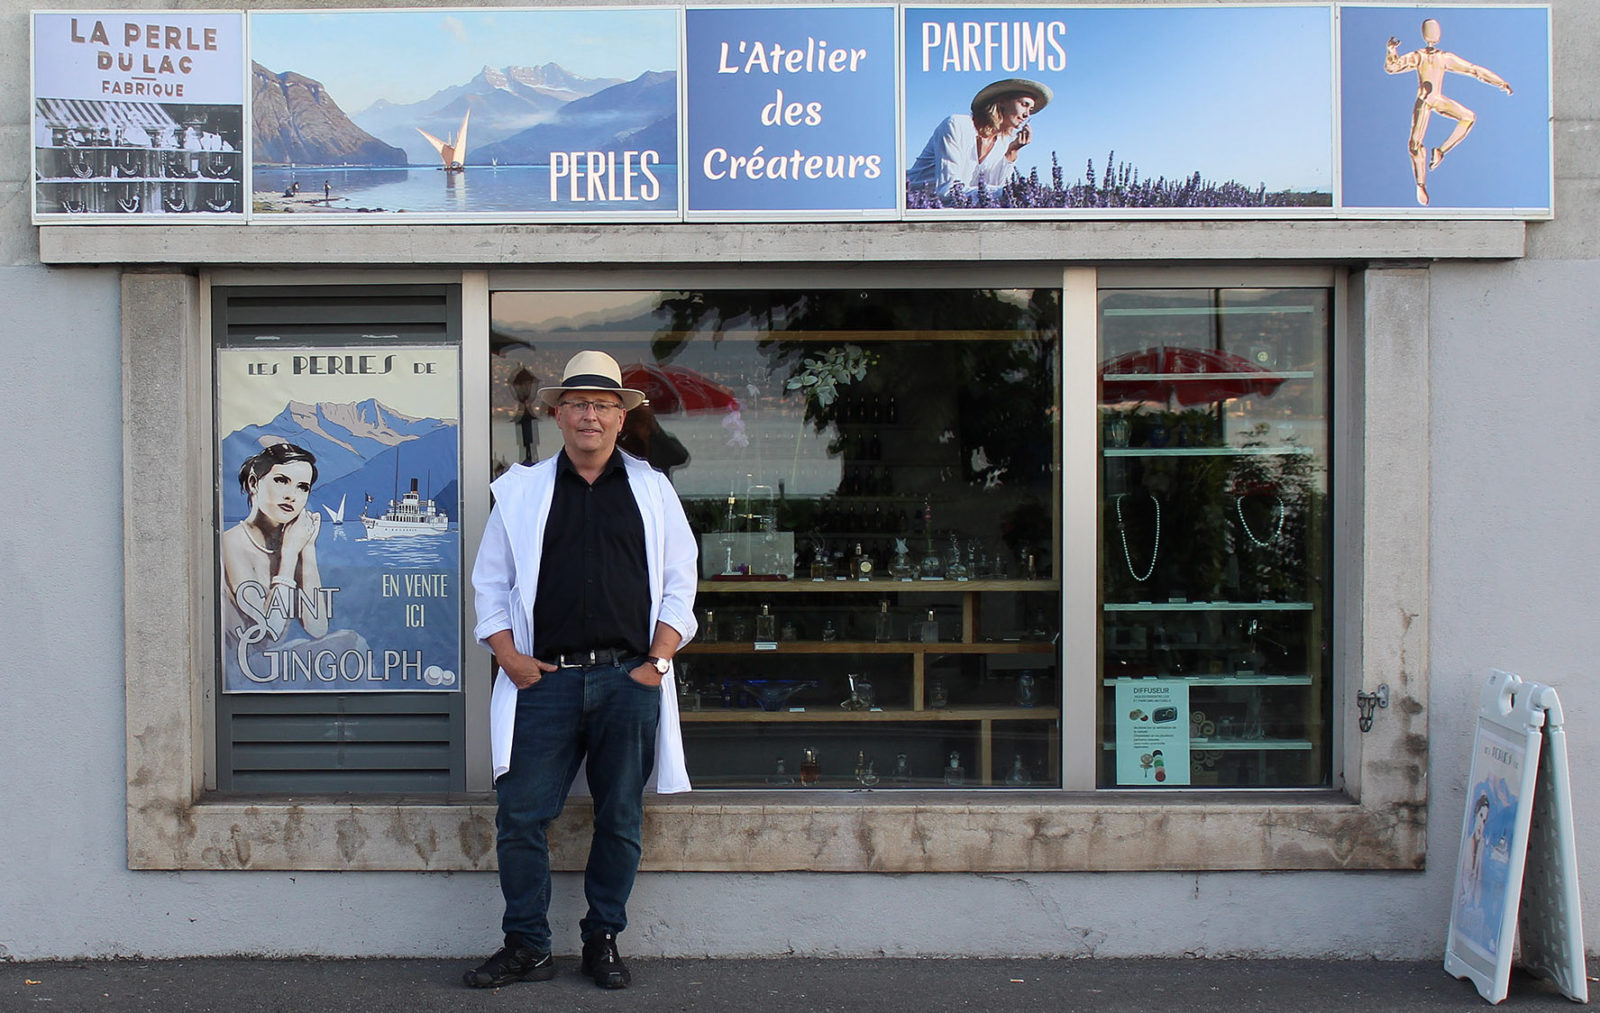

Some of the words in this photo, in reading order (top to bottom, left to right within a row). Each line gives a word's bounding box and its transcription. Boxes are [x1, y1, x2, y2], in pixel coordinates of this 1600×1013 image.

[71, 18, 110, 46] LA
[124, 23, 217, 51] PERLE
[922, 21, 1066, 72] PARFUMS
[97, 51, 133, 72] DU
[143, 54, 193, 74] LAC
[718, 36, 867, 74] L'Atelier
[102, 80, 184, 97] FABRIQUE
[761, 89, 822, 126] des
[550, 150, 660, 202] PERLES
[703, 146, 882, 181] Créateurs
[248, 363, 280, 375] LES
[293, 355, 397, 375] PERLES
[413, 362, 437, 374] DE
[382, 574, 400, 597] EN
[405, 574, 448, 597] VENTE
[235, 580, 340, 641] SAINT
[406, 604, 425, 628] ICI
[235, 626, 422, 683] GINGOLPH
